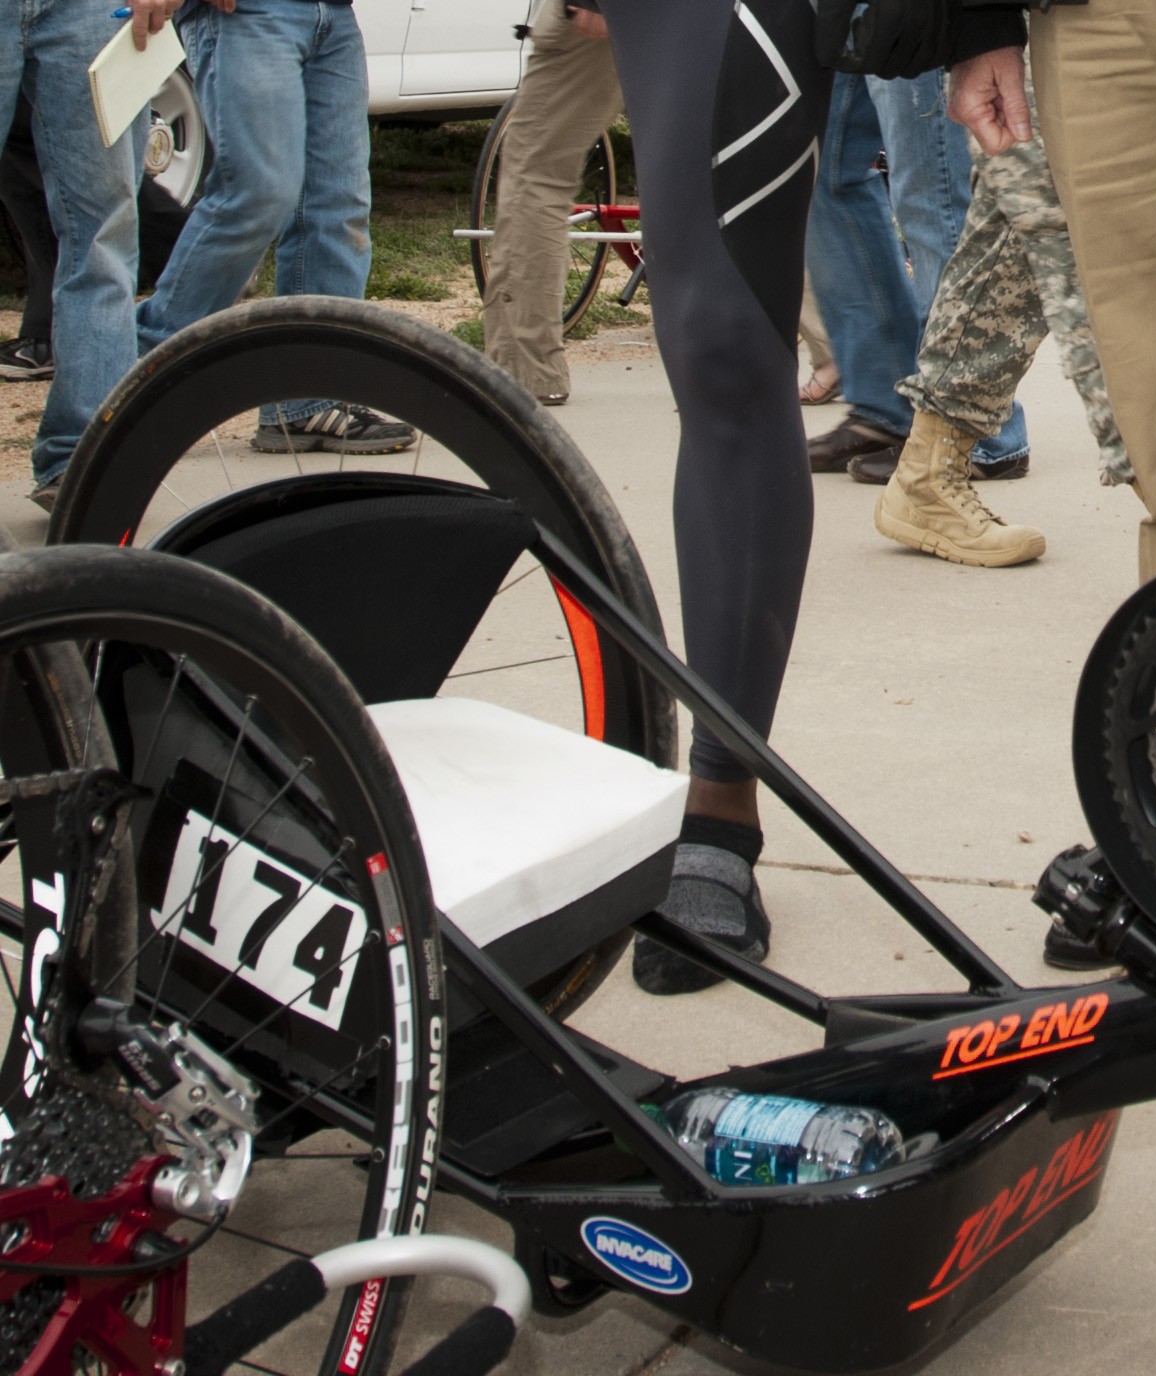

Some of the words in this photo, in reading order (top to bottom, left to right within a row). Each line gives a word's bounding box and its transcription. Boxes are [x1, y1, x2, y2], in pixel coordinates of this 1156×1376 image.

[182, 836, 354, 1012] 174
[940, 1013, 1021, 1068] TOP
[1021, 992, 1109, 1049] END
[409, 1015, 443, 1237] DURANO
[597, 1234, 672, 1273] INVACARE
[929, 1167, 1038, 1290] TOP
[1022, 1108, 1121, 1221] END
[344, 1335, 363, 1370] DT
[356, 1279, 381, 1336] SWISS
